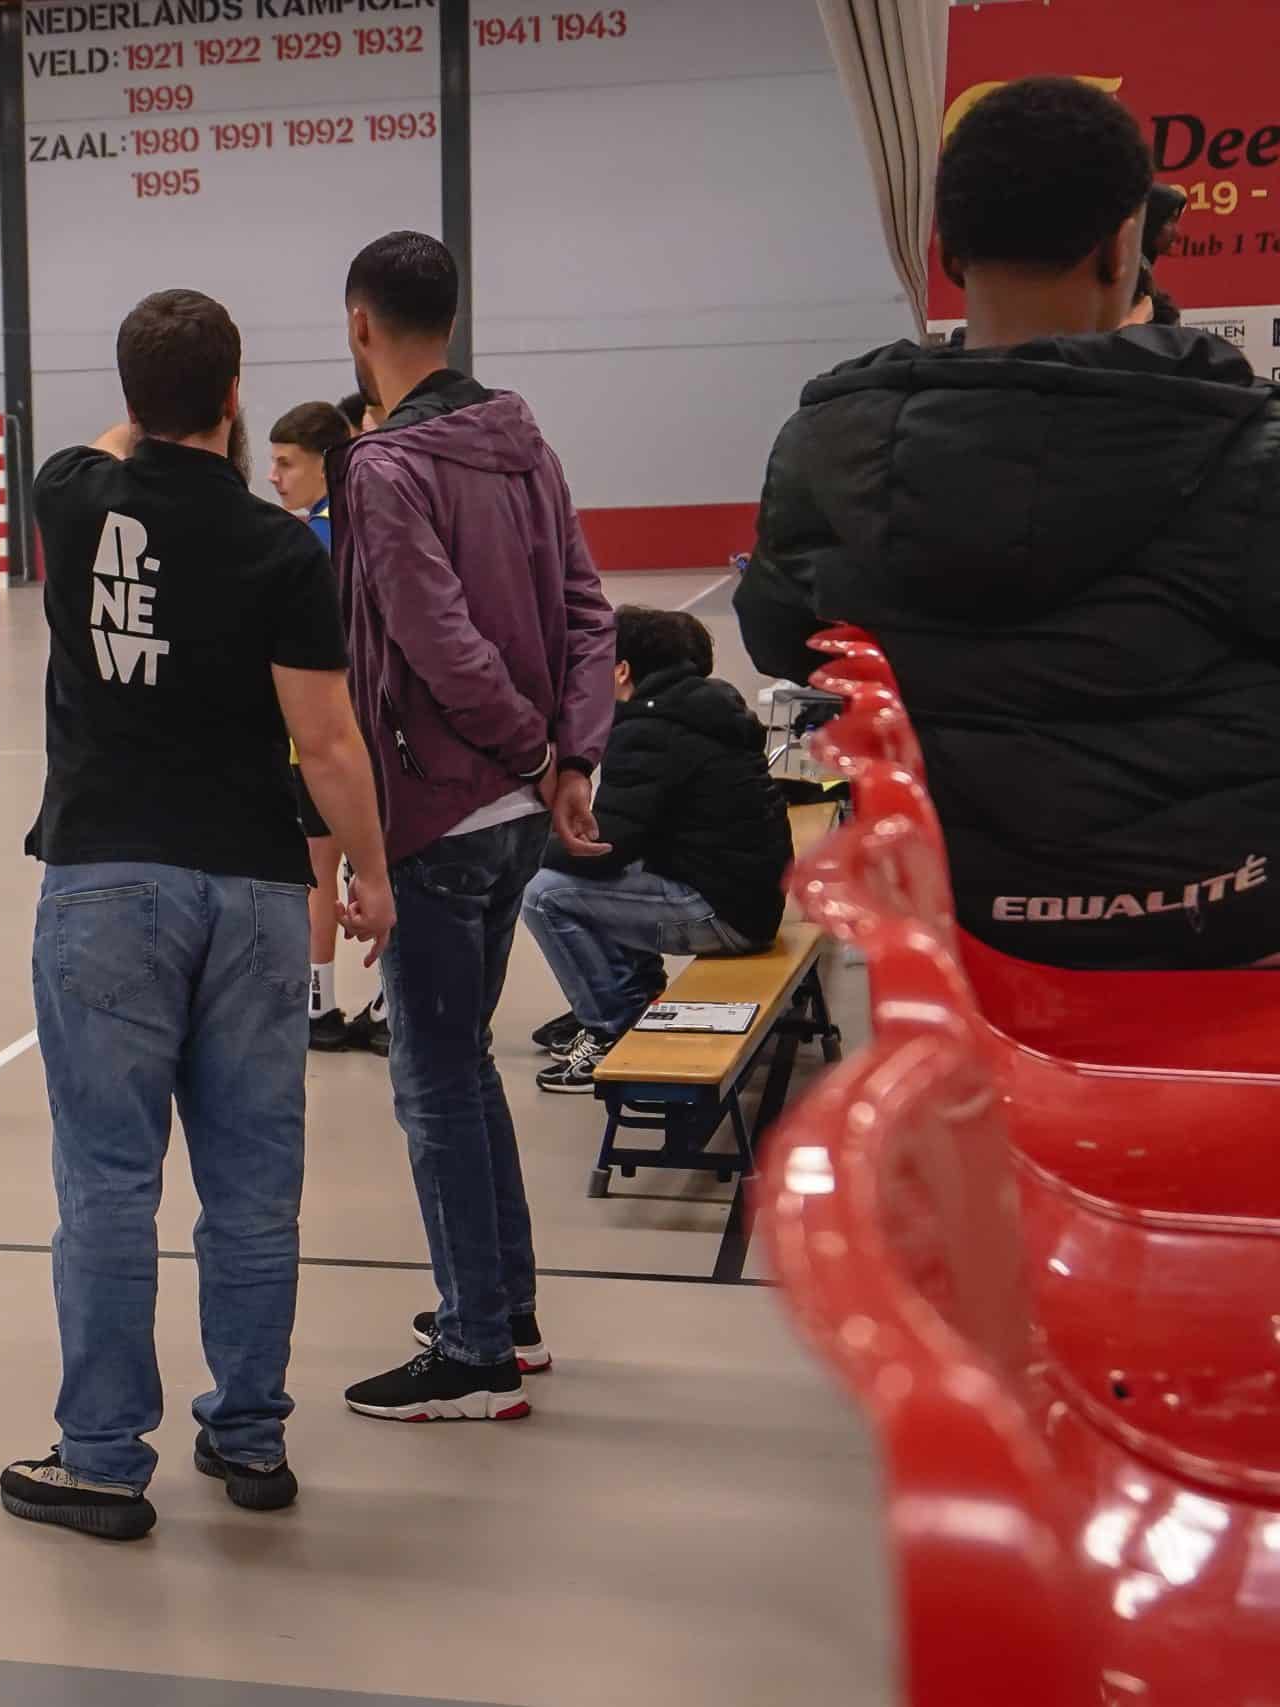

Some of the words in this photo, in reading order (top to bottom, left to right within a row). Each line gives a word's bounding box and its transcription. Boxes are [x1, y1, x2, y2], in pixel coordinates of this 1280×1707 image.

[25, 0, 244, 36] NEDERLANDS
[28, 47, 119, 78] VELD:
[123, 41, 184, 71] 1921
[194, 36, 261, 67] 1922
[272, 31, 342, 61] 1929
[353, 25, 424, 56] 1932
[473, 15, 540, 46] 1941
[552, 9, 627, 42] 1943
[123, 84, 194, 113] 1999
[30, 132, 126, 162] ZAAL:
[130, 126, 199, 156] 1980
[209, 121, 273, 151] 1991
[283, 116, 354, 147] 1992
[364, 111, 437, 142] 1993
[131, 168, 201, 199] 1995
[991, 853, 1268, 922] EQUALITÉ
